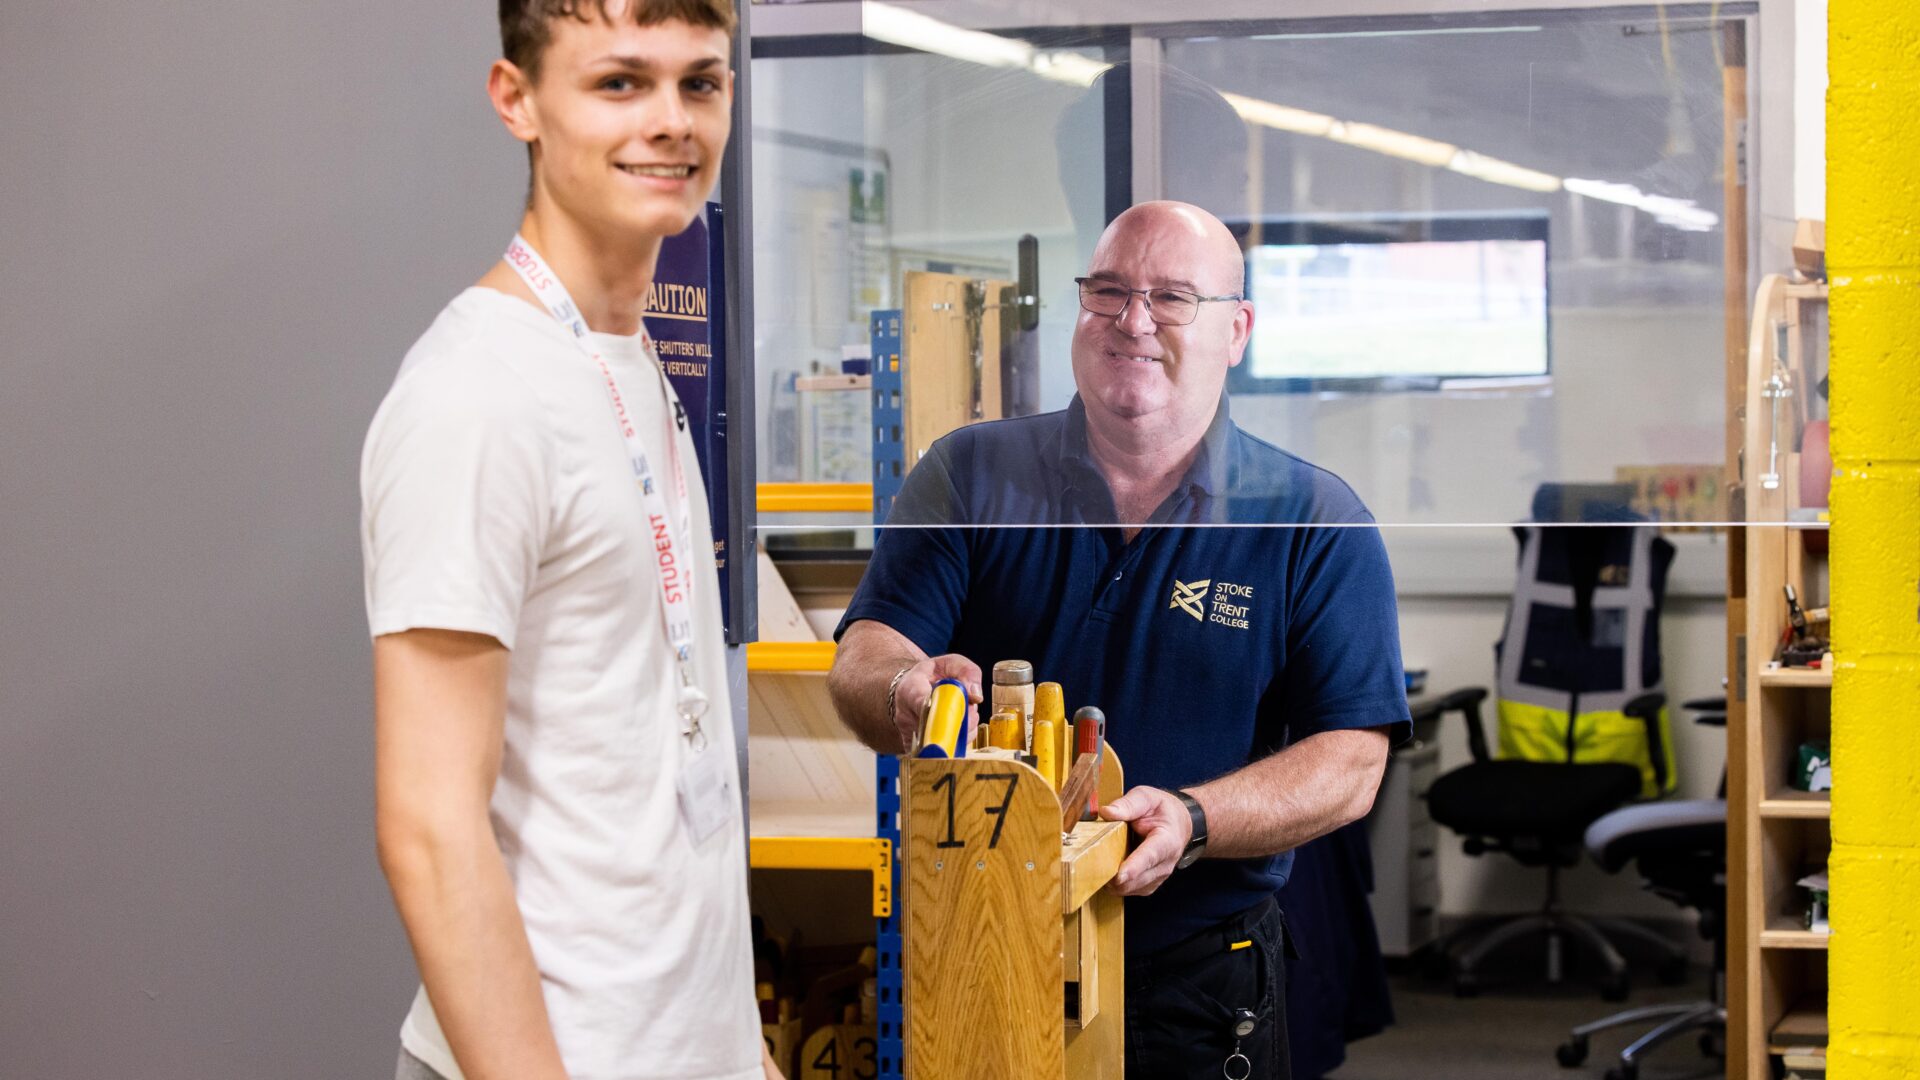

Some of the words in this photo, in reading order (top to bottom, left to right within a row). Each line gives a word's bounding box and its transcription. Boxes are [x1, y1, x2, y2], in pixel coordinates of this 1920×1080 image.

[659, 341, 695, 357] SHUTTERS
[695, 343, 712, 358] WILL
[667, 362, 708, 377] VERTICALLY
[649, 514, 683, 604] STUDENT
[1214, 593, 1228, 602] ON
[1216, 582, 1253, 598] STOKE
[1212, 601, 1249, 618] TRENT
[1210, 613, 1249, 629] COLLEGE
[931, 772, 1020, 850] 17
